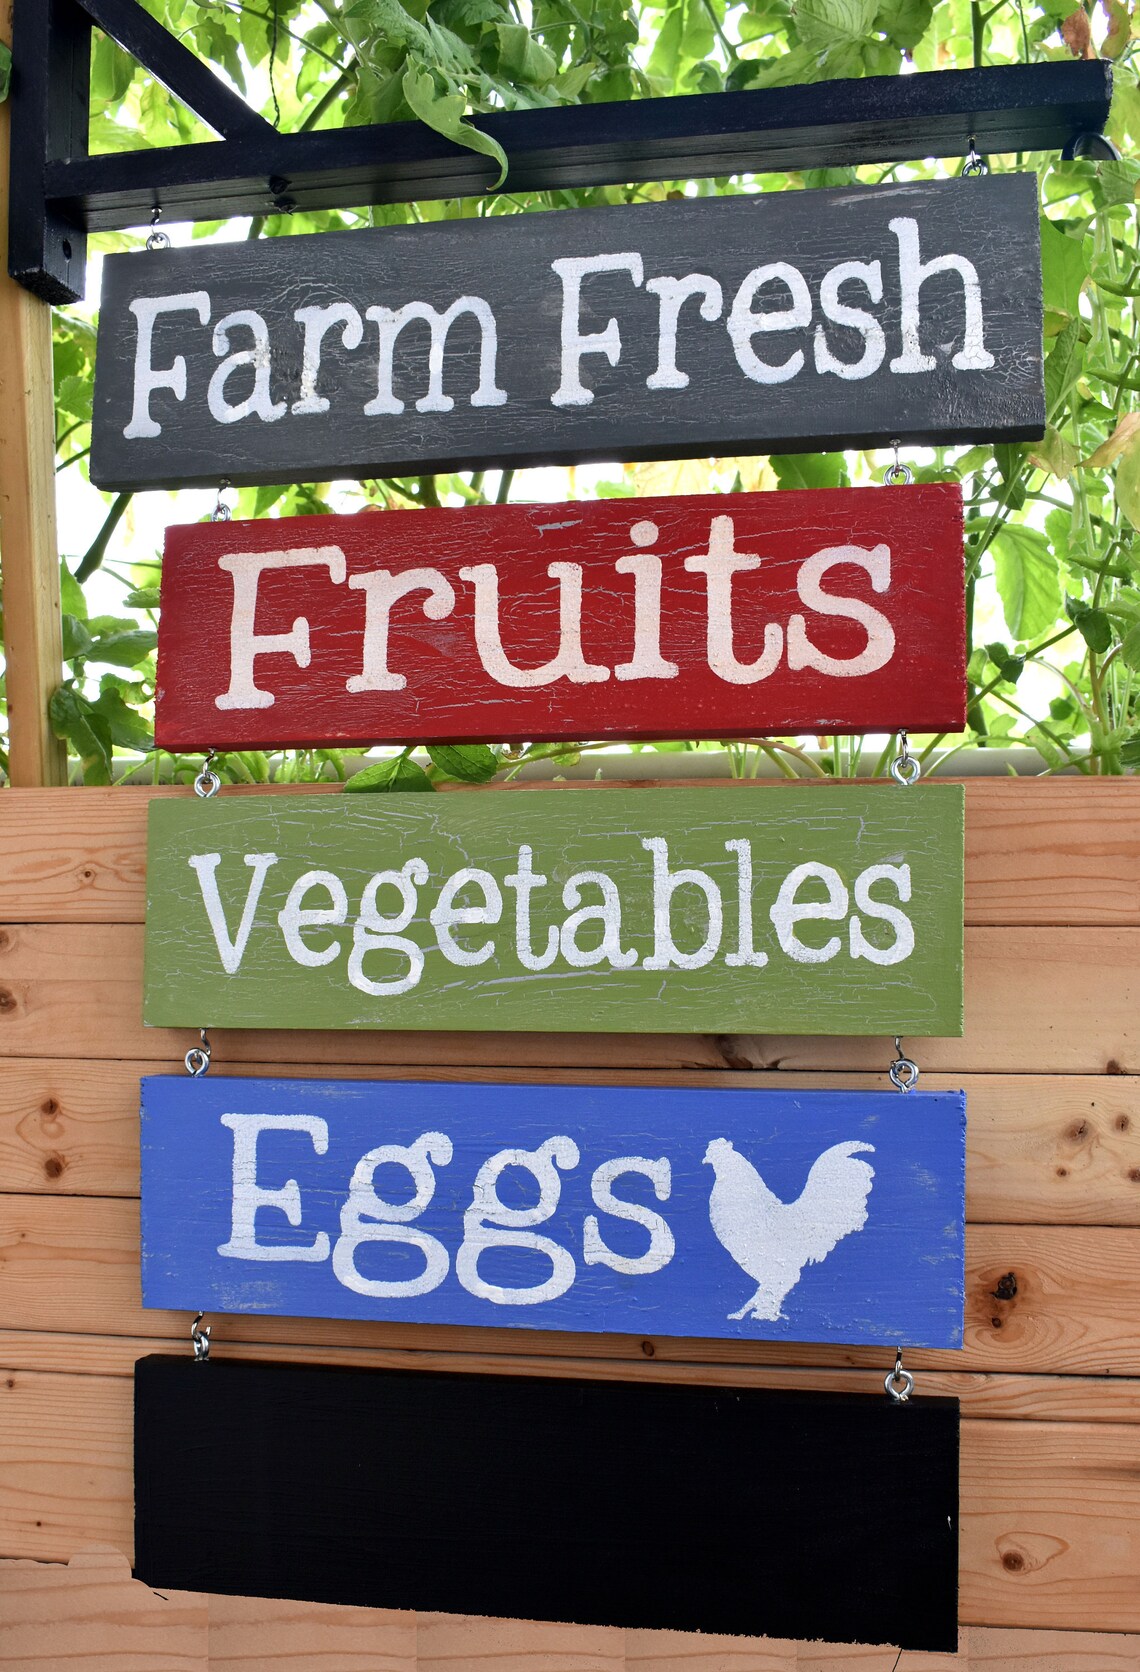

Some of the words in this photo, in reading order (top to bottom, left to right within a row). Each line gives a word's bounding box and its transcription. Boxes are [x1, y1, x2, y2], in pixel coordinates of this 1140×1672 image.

[123, 291, 507, 439] Farm
[551, 217, 995, 407] Fresh
[214, 514, 895, 709] Fruits
[188, 838, 916, 996] Vegetables
[217, 1112, 676, 1306] Eggs
